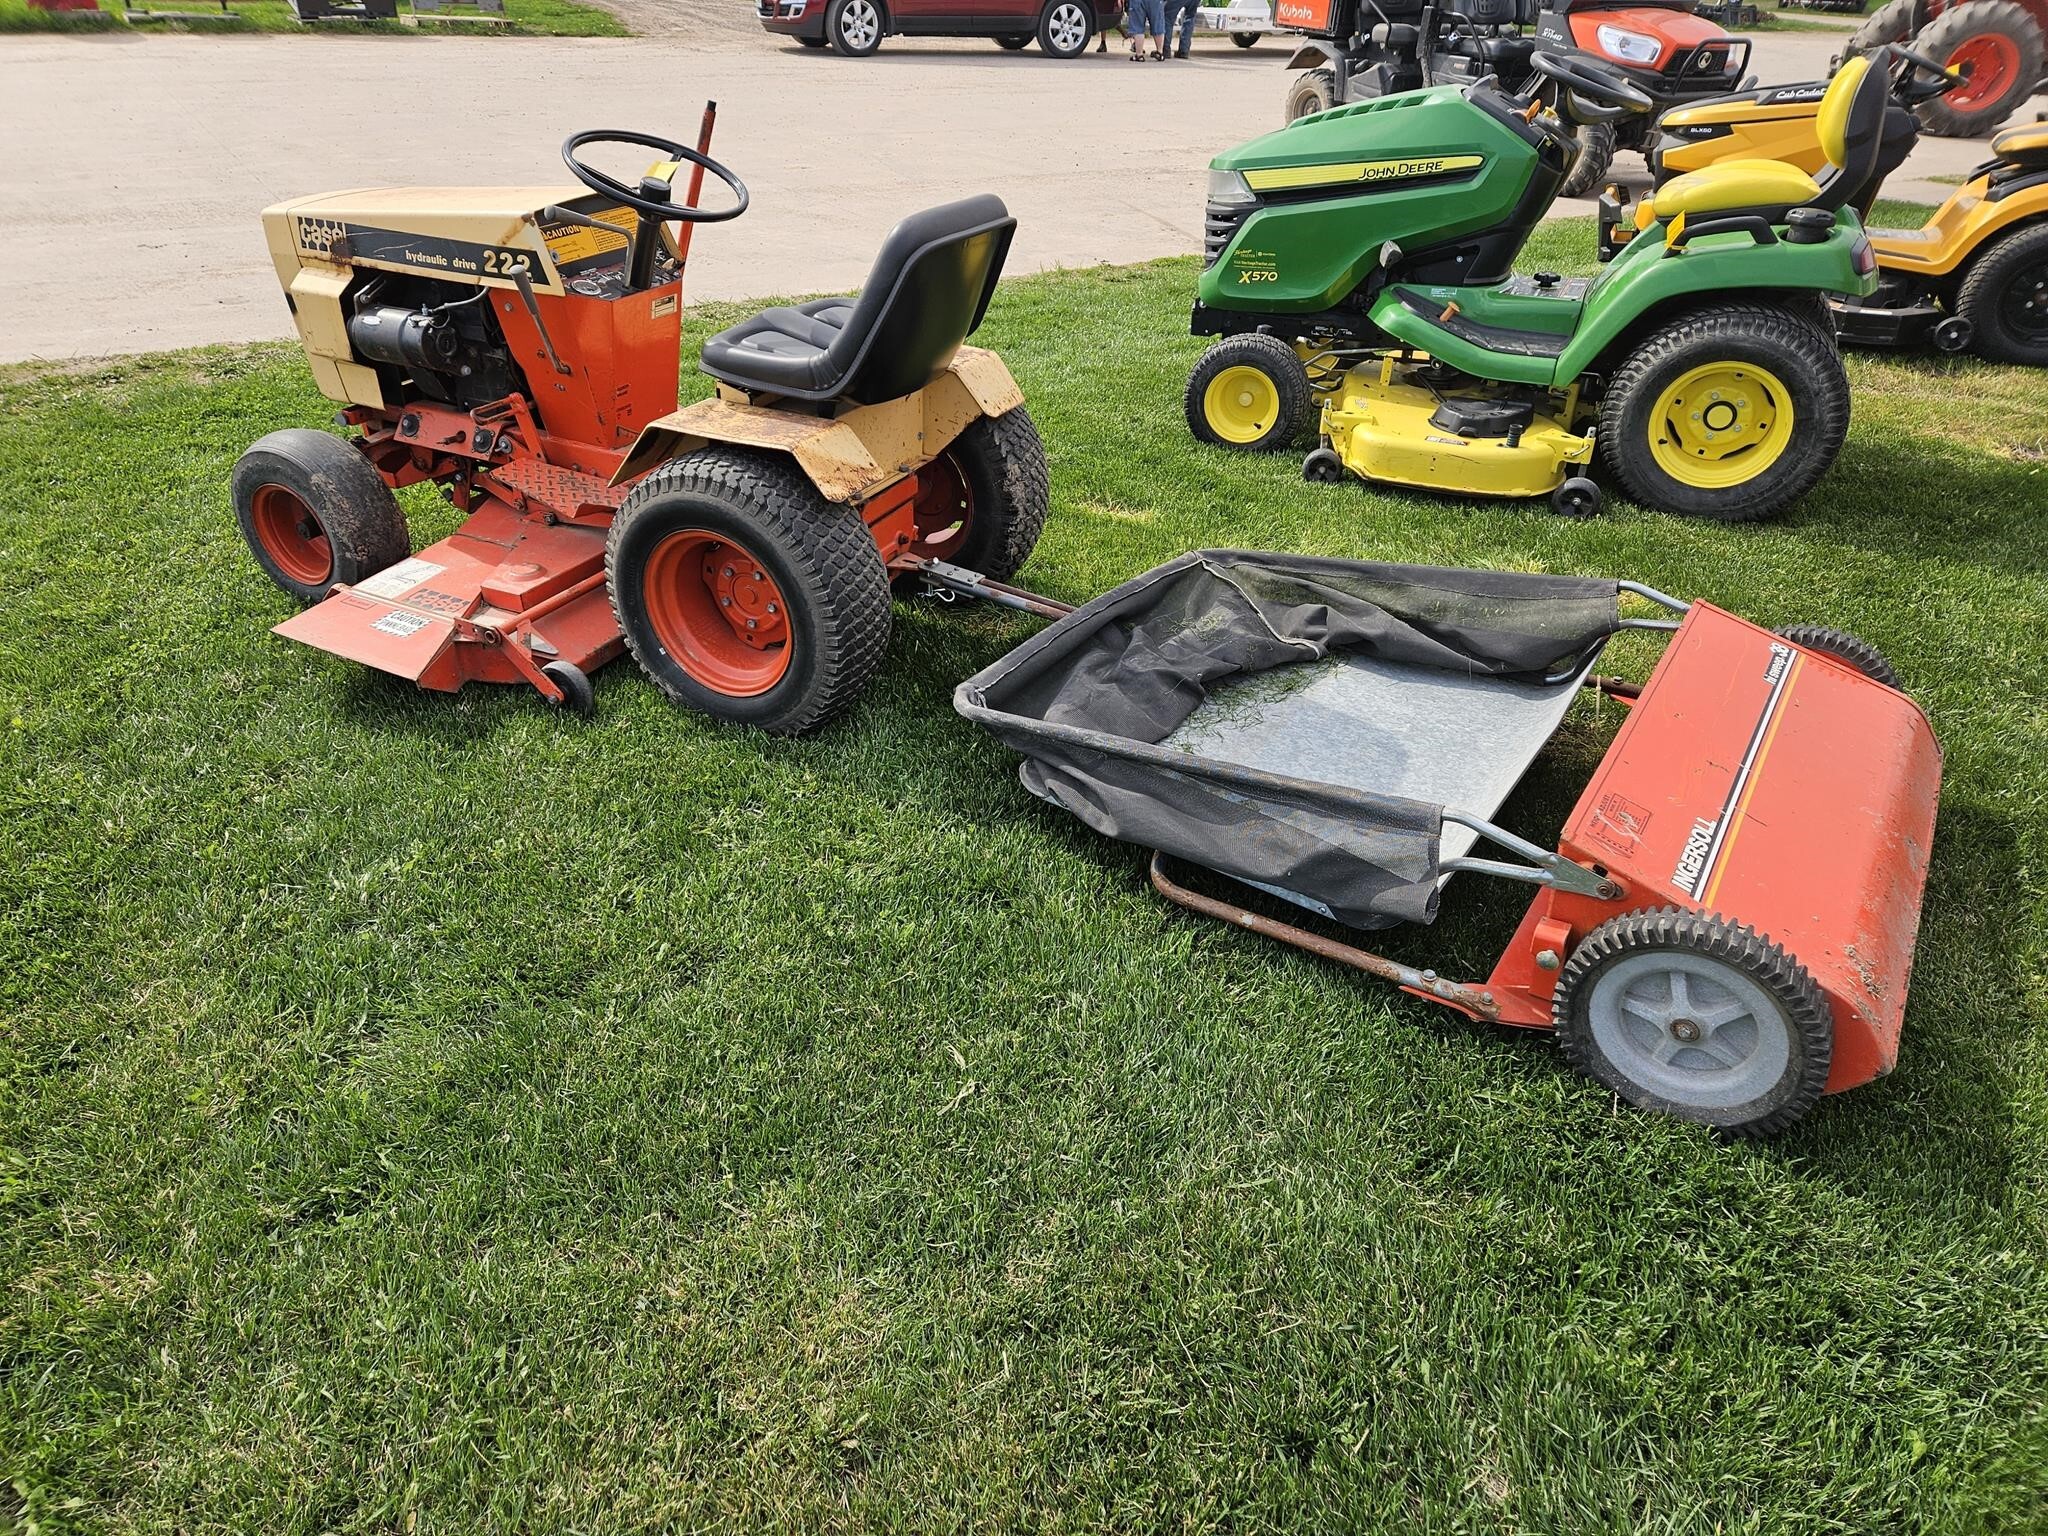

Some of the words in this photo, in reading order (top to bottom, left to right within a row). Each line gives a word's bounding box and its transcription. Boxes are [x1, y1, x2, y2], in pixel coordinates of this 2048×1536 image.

[1280, 3, 1312, 20] Kubota
[1775, 90, 1796, 99] Cub
[1359, 167, 1395, 179] JOHN
[1398, 160, 1444, 175] DEERE
[546, 224, 582, 239] CAUTION
[405, 250, 448, 266] hydraulic
[452, 257, 477, 270] drive
[1238, 270, 1278, 284] X570
[1768, 641, 1790, 657] 38
[1768, 655, 1787, 679] sweep
[1671, 816, 1718, 893] INGERSOLL
